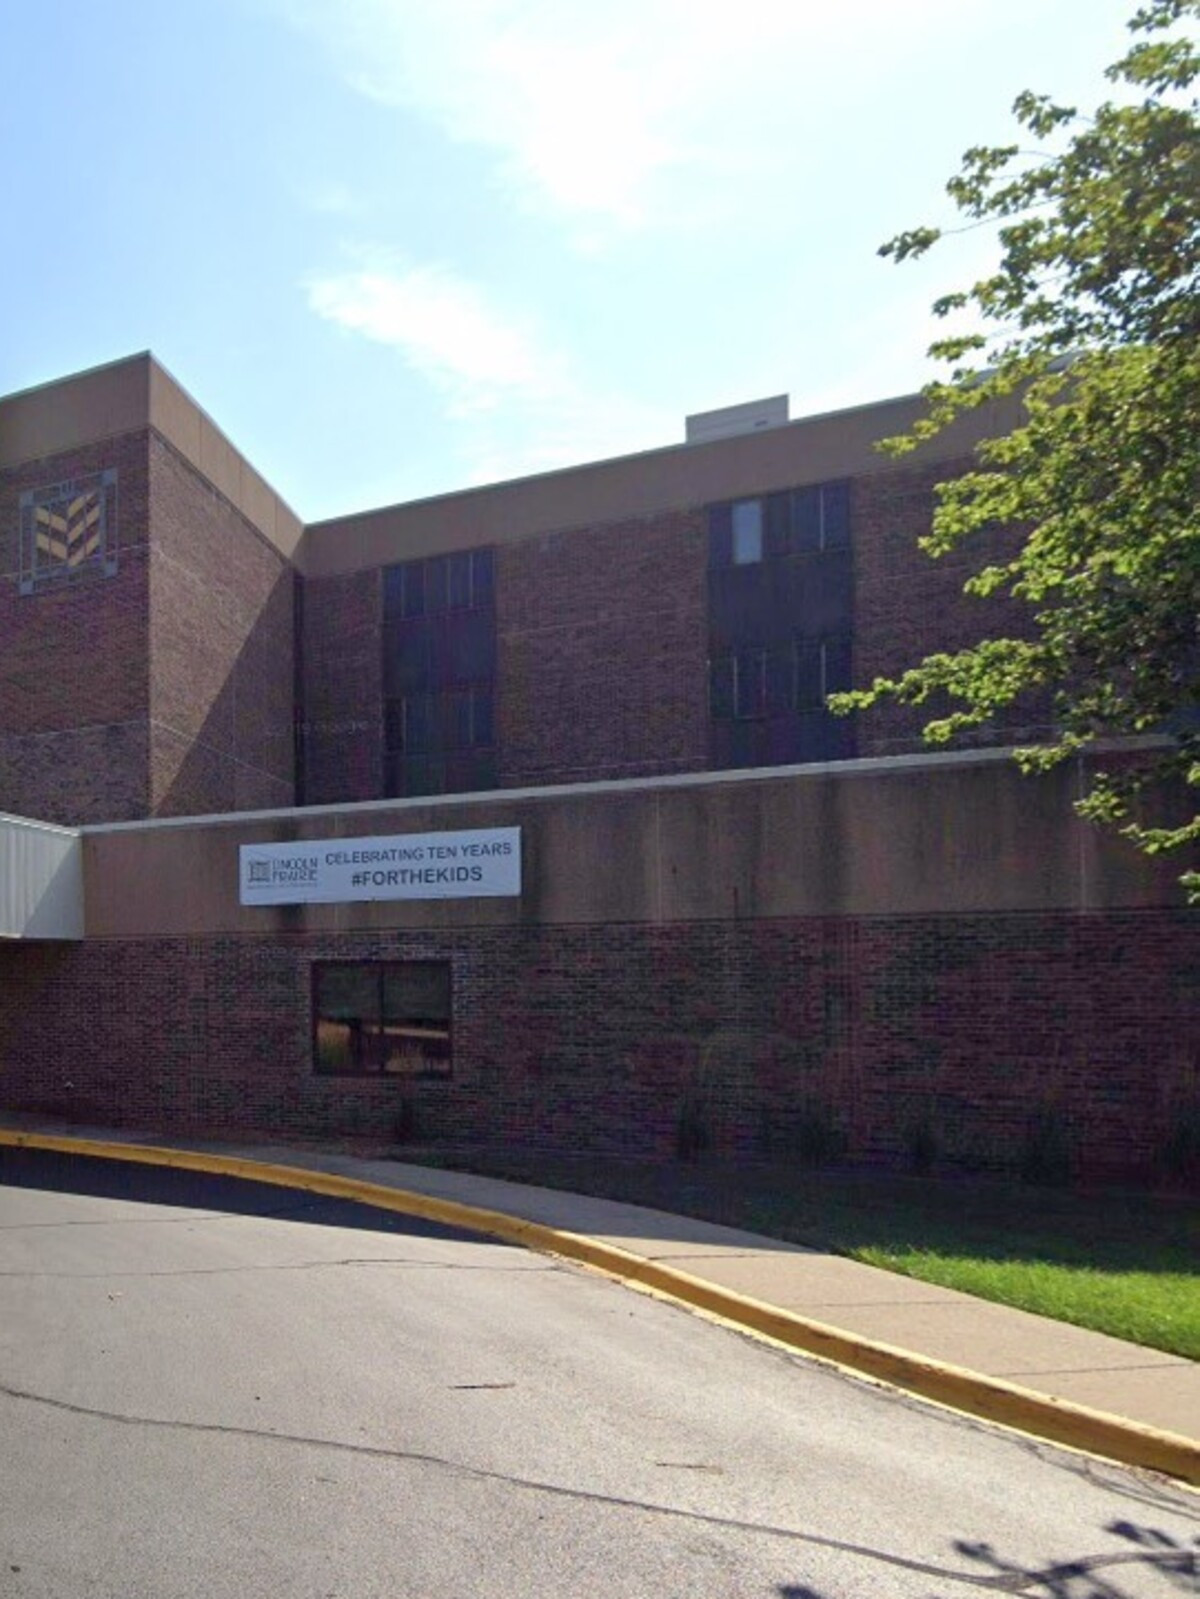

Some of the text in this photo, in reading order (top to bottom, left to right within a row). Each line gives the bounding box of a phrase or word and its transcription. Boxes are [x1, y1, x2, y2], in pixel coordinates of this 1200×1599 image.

[325, 842, 512, 866] CELEBRATING TEN YEARS
[351, 866, 483, 887] #FORTHEKIDS
